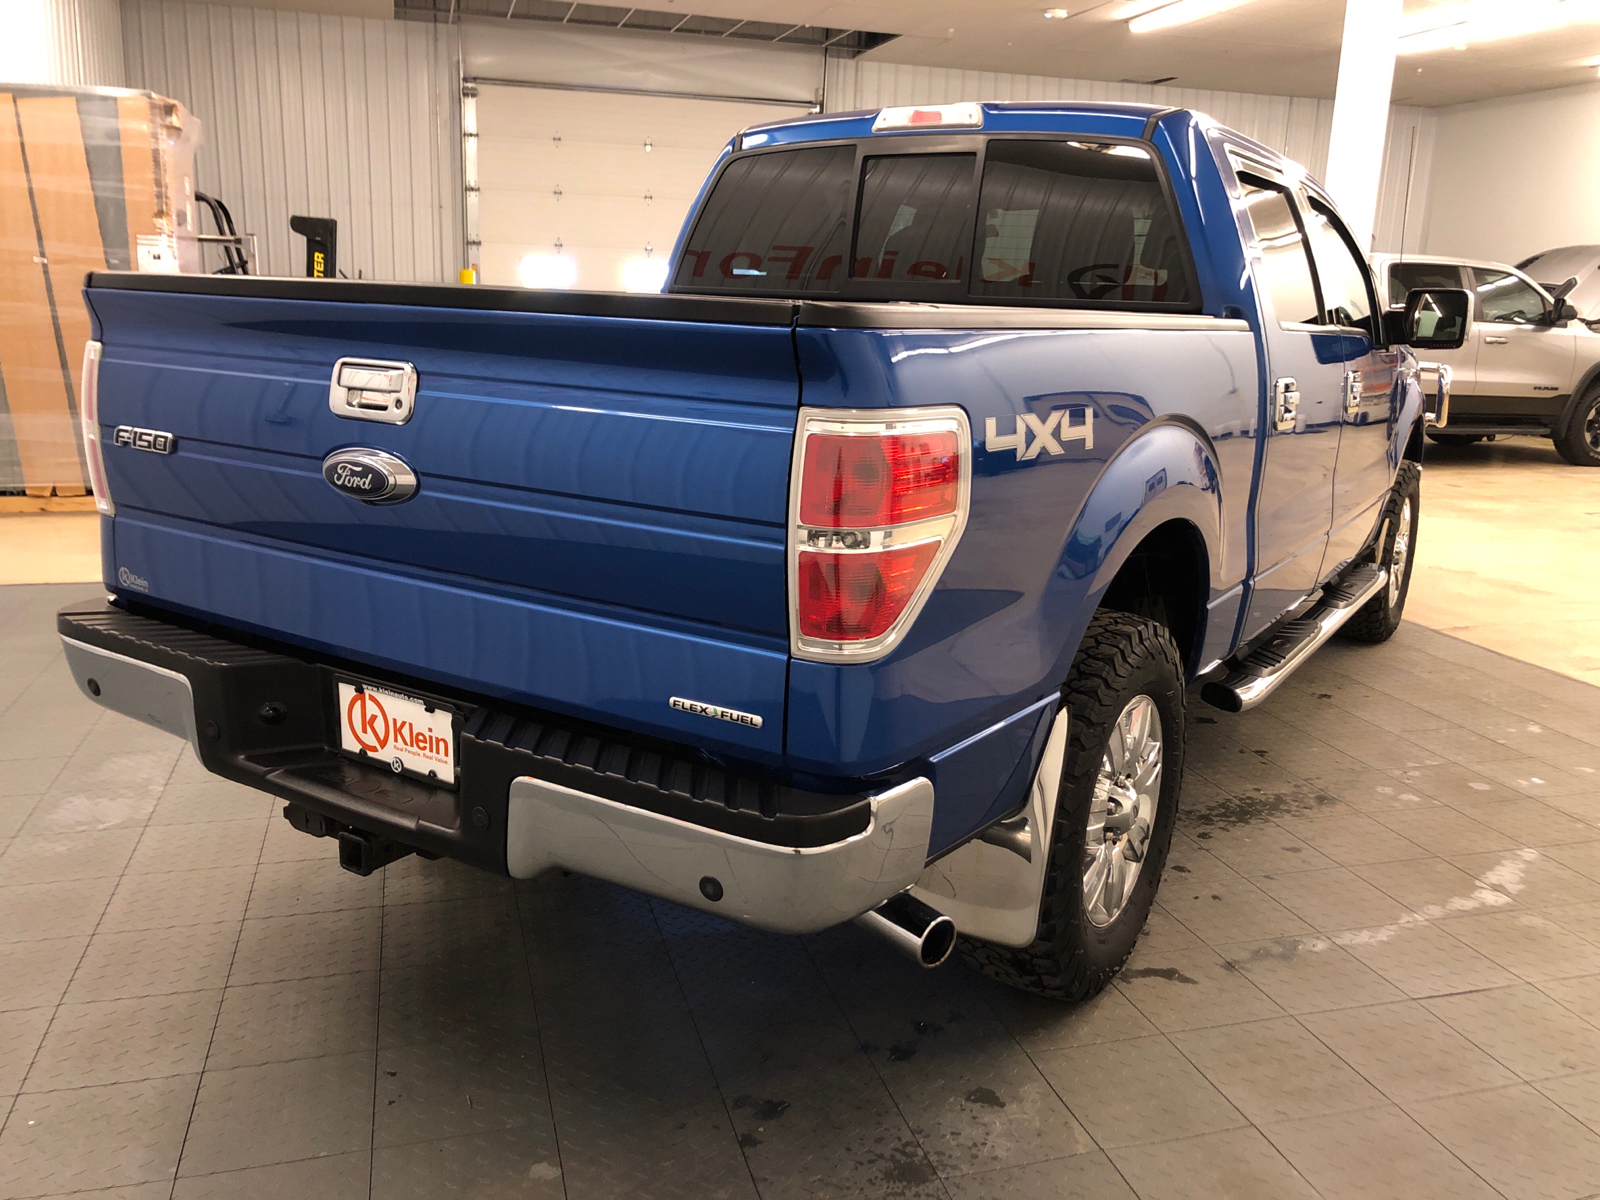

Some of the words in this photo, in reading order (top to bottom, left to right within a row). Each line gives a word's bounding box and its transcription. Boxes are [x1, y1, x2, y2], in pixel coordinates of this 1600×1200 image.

[114, 425, 174, 454] F-150
[334, 463, 372, 489] Ford
[362, 683, 425, 705] www.kleinauto.com
[672, 699, 710, 716] FLEX
[719, 710, 759, 727] FUEL
[392, 717, 449, 758] Klein
[393, 744, 404, 753] Real
[422, 752, 434, 761] Real
